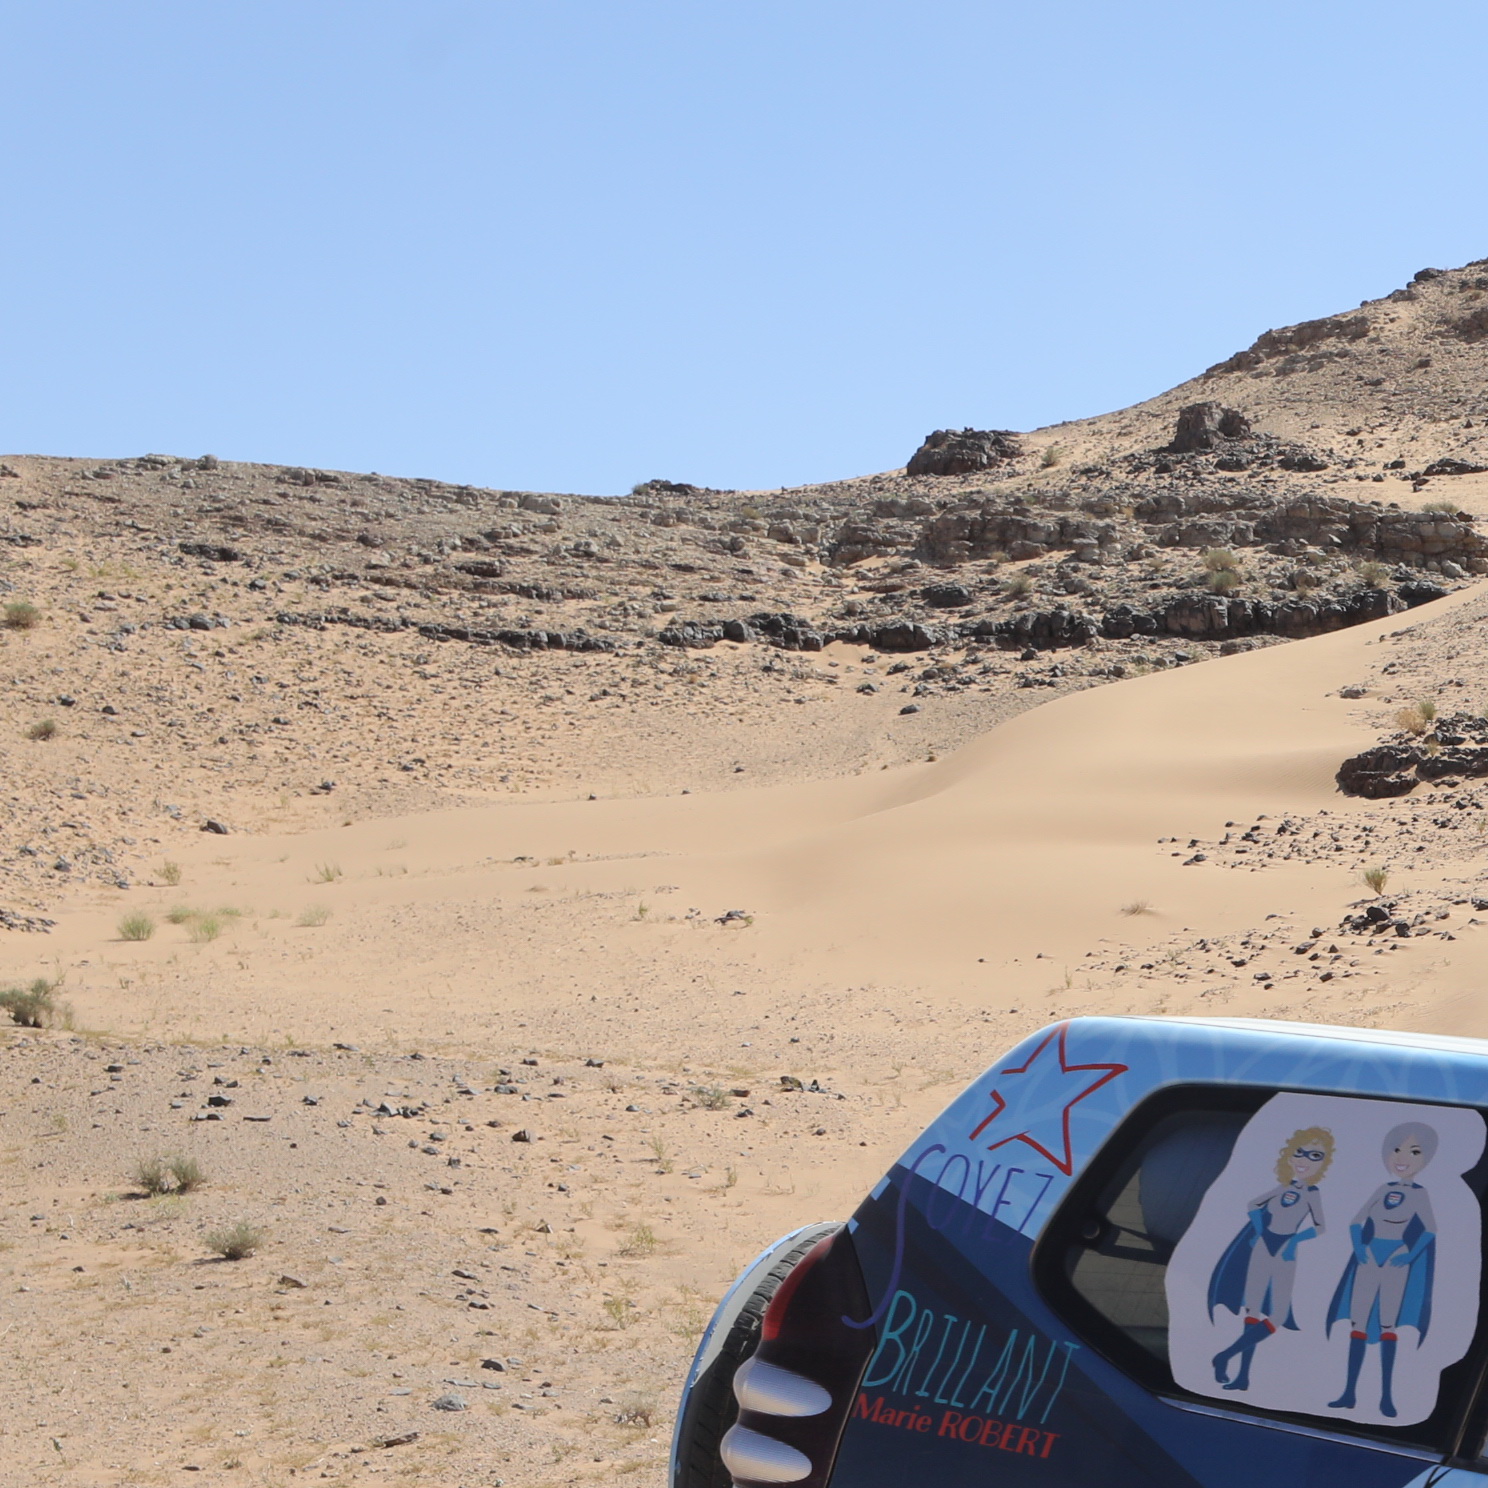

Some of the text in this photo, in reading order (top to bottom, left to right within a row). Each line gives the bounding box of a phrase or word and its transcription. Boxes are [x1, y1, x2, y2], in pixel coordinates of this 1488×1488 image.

[861, 1289, 1080, 1424] BRILLANT
[852, 1393, 1061, 1458] Marie ROBERT
